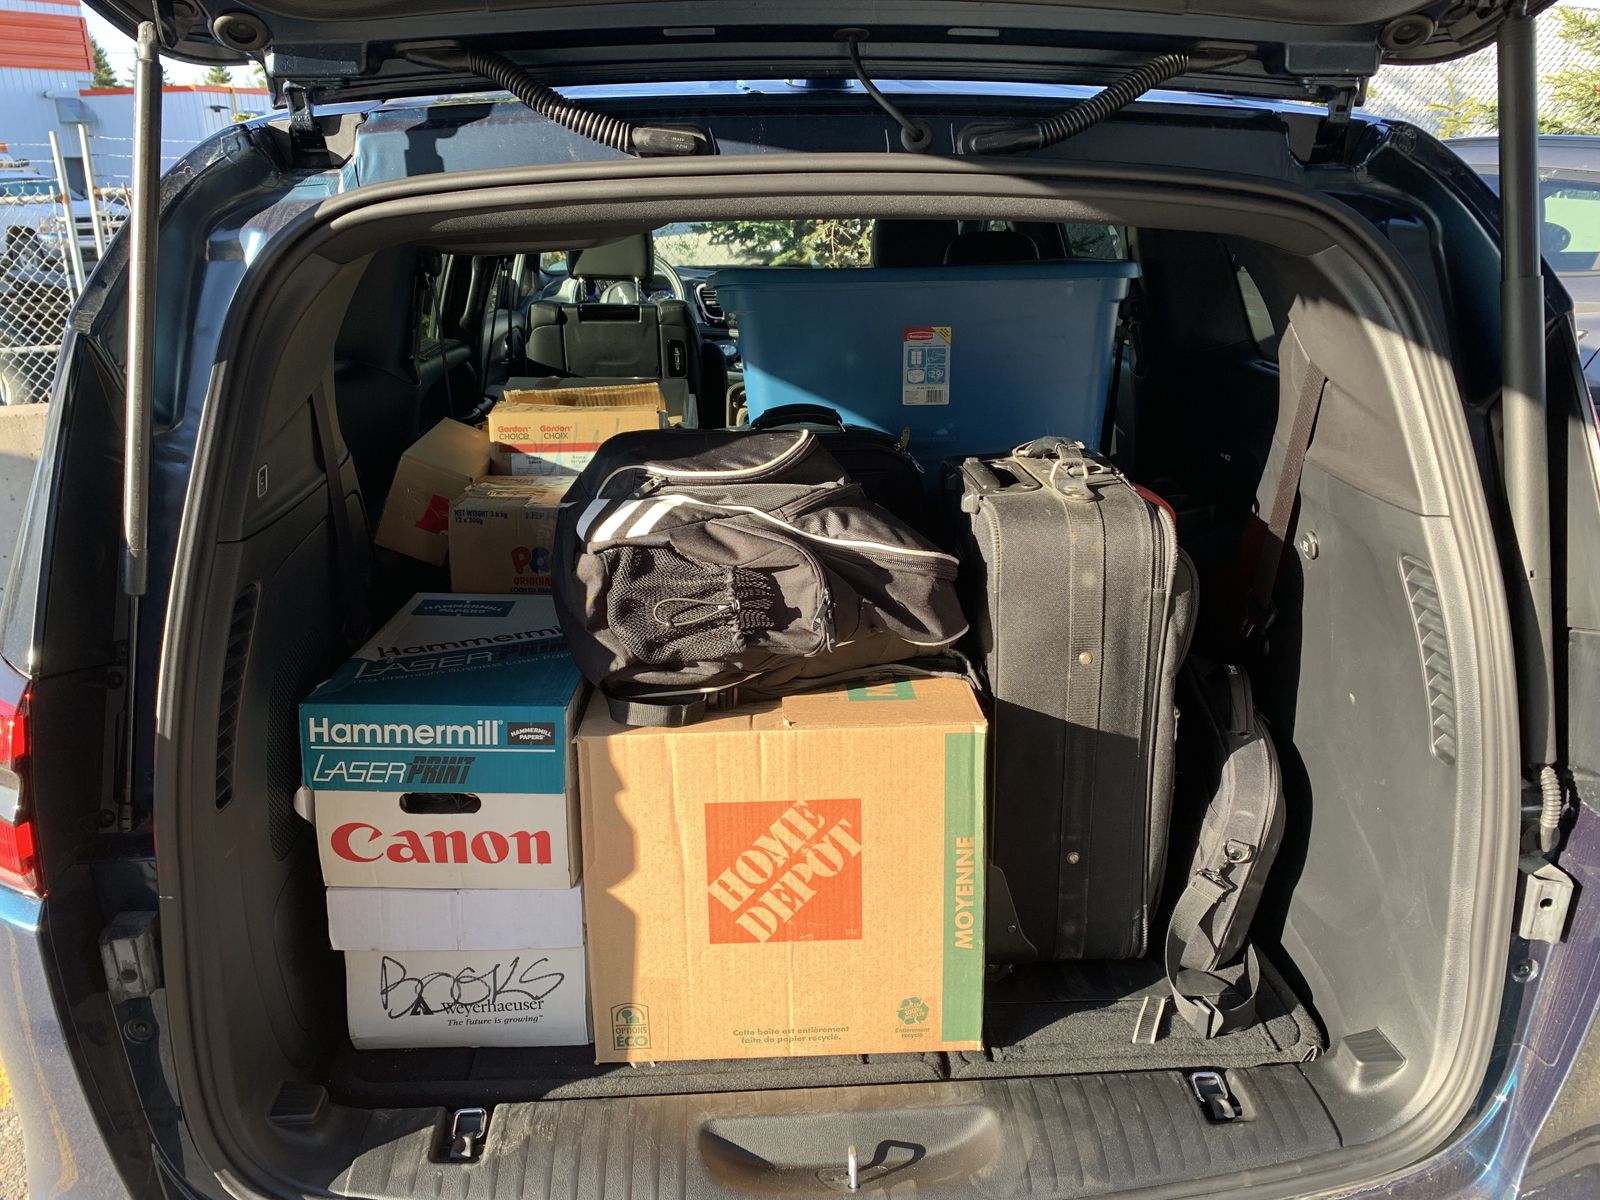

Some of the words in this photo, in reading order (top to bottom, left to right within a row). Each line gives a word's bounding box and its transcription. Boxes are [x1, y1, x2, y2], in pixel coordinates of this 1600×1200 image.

[543, 432, 569, 440] CHOIX
[454, 509, 465, 517] NET
[513, 576, 551, 586] ORIGINA
[377, 625, 562, 658] Hammermi
[354, 651, 494, 679] LASER
[510, 726, 552, 738] HAMMERMILL
[330, 822, 552, 865] Canon
[707, 799, 826, 913] HOME
[735, 817, 863, 944] DEPOT
[954, 836, 976, 950] MOYENNE
[441, 999, 546, 1018] Weyerhaeuser
[447, 1018, 464, 1027] The
[466, 1017, 492, 1026] future
[494, 1016, 502, 1025] is
[615, 1026, 648, 1035] OPTIONS
[732, 1029, 755, 1037] Cette
[757, 1027, 780, 1036] boîte
[797, 1026, 850, 1035] entièrement
[741, 1036, 761, 1044] faite
[763, 1035, 775, 1043] de
[776, 1036, 806, 1044] papier
[808, 1033, 841, 1043] recyclé.
